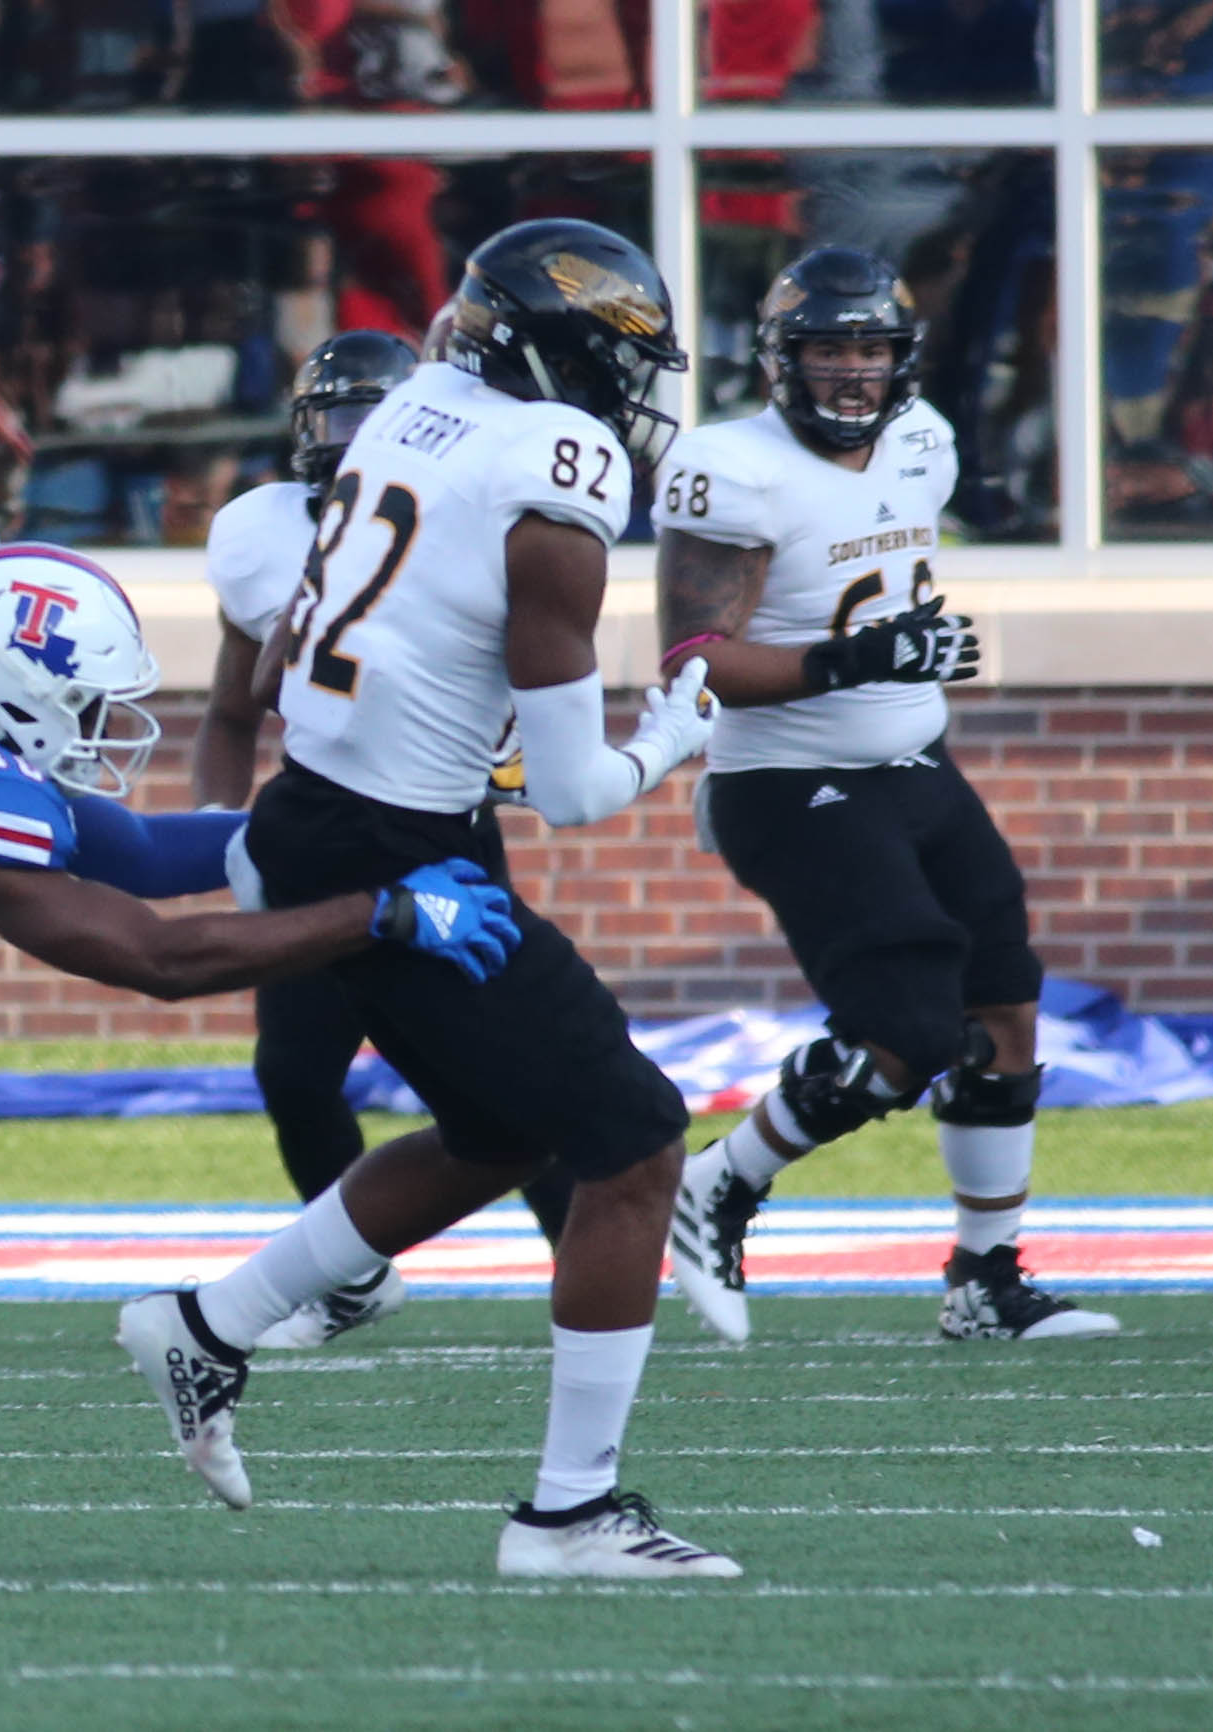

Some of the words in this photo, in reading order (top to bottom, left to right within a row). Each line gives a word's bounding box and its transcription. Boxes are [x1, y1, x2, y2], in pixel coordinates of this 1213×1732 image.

[551, 437, 613, 502] 82
[667, 469, 709, 518] 68
[827, 528, 908, 568] SOUTHERN
[284, 467, 422, 701] 82
[164, 1346, 198, 1442] adidas
